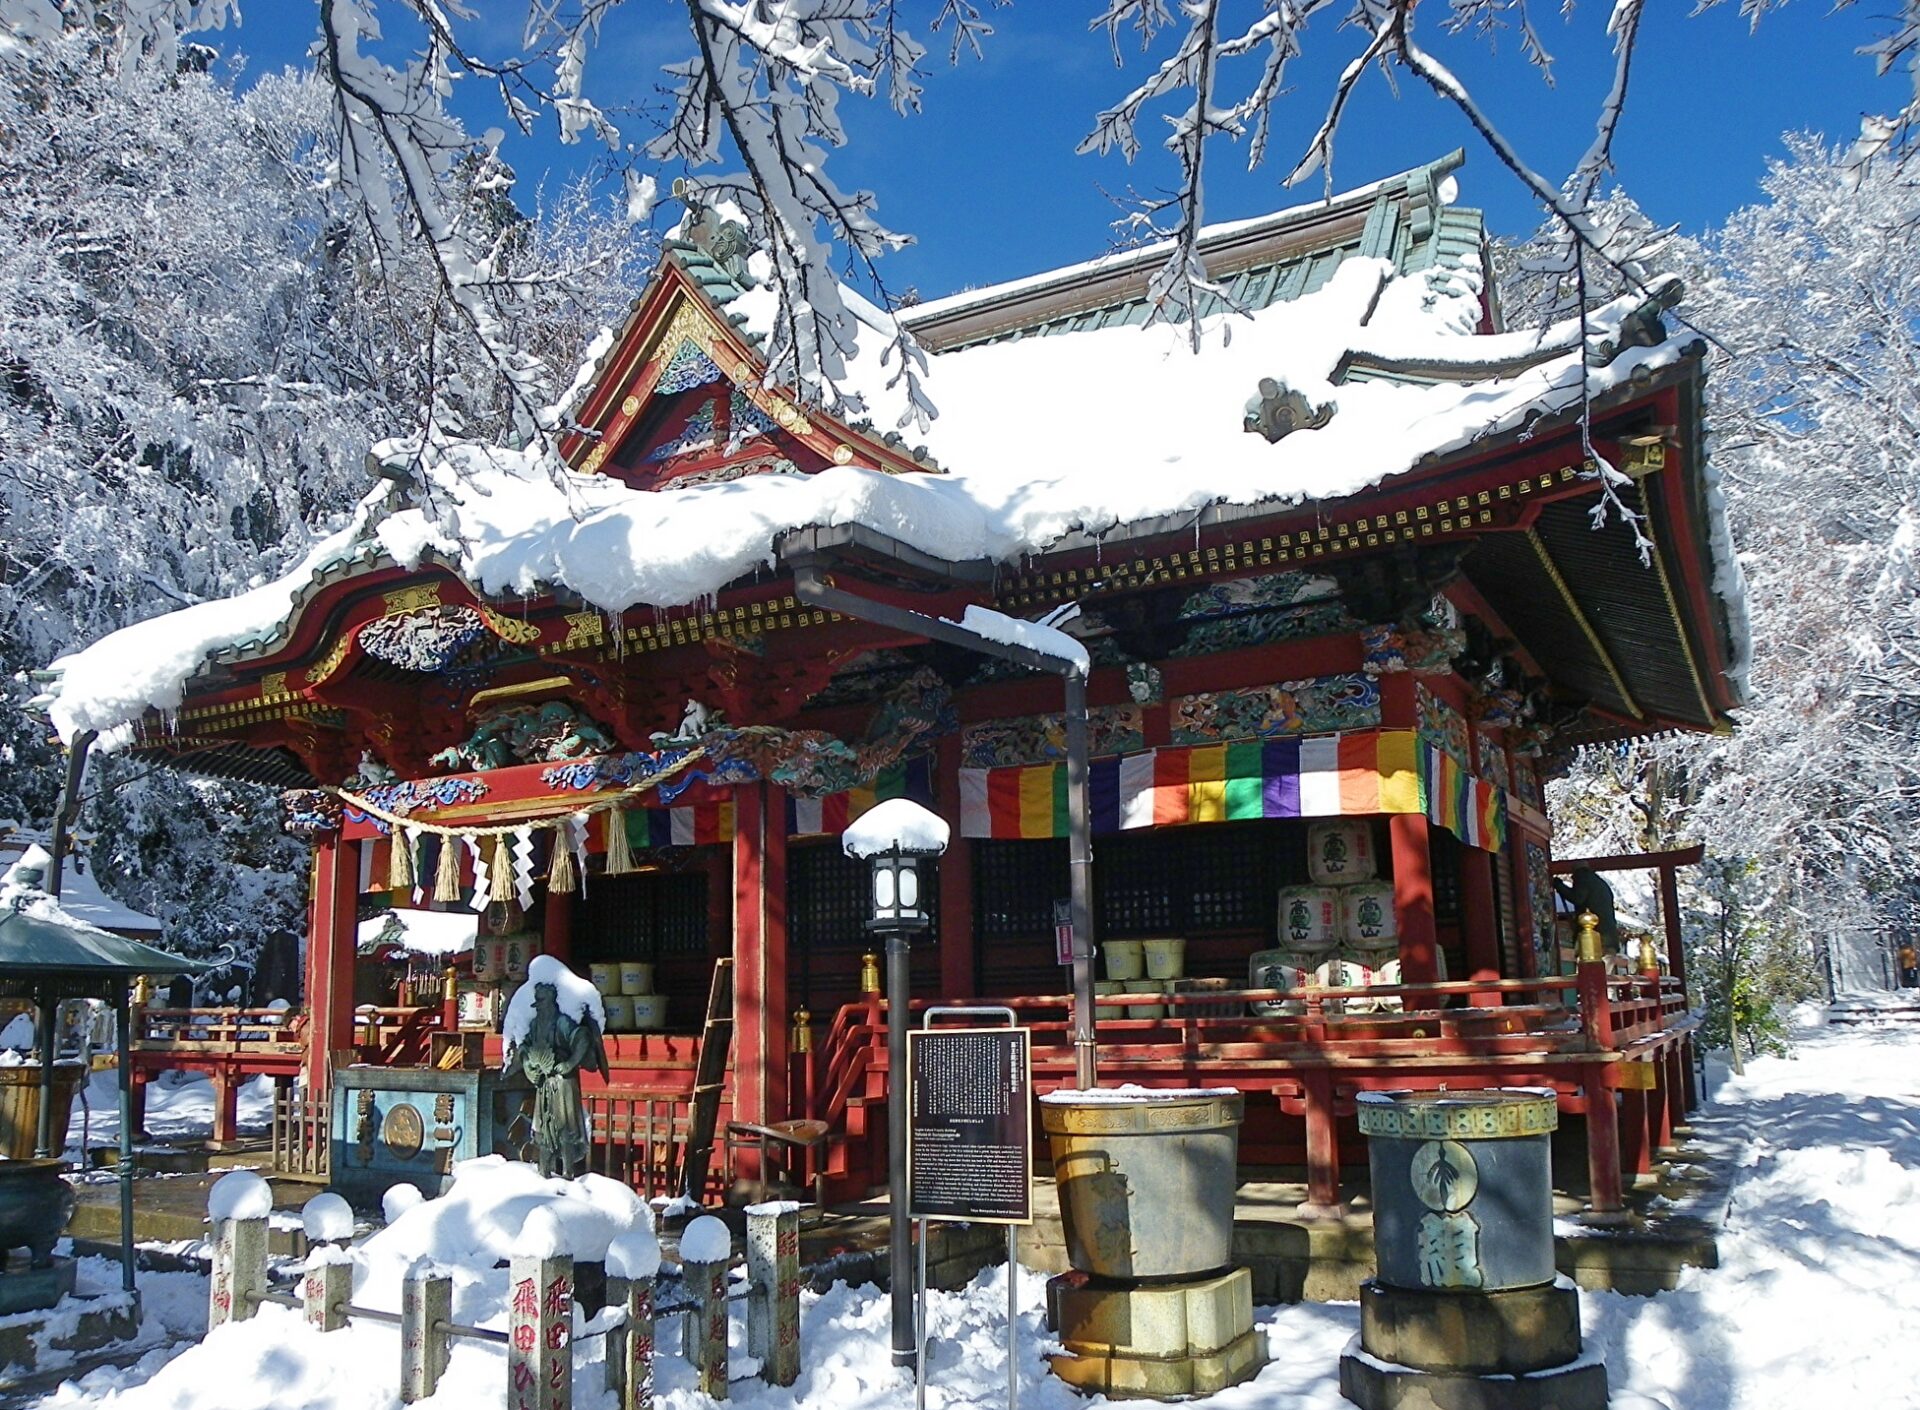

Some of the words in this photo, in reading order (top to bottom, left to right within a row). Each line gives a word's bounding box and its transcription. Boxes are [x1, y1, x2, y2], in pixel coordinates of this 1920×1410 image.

[1322, 832, 1348, 873] 高尾山
[1288, 898, 1312, 941] 高尾山
[1357, 895, 1383, 939] 高尾山
